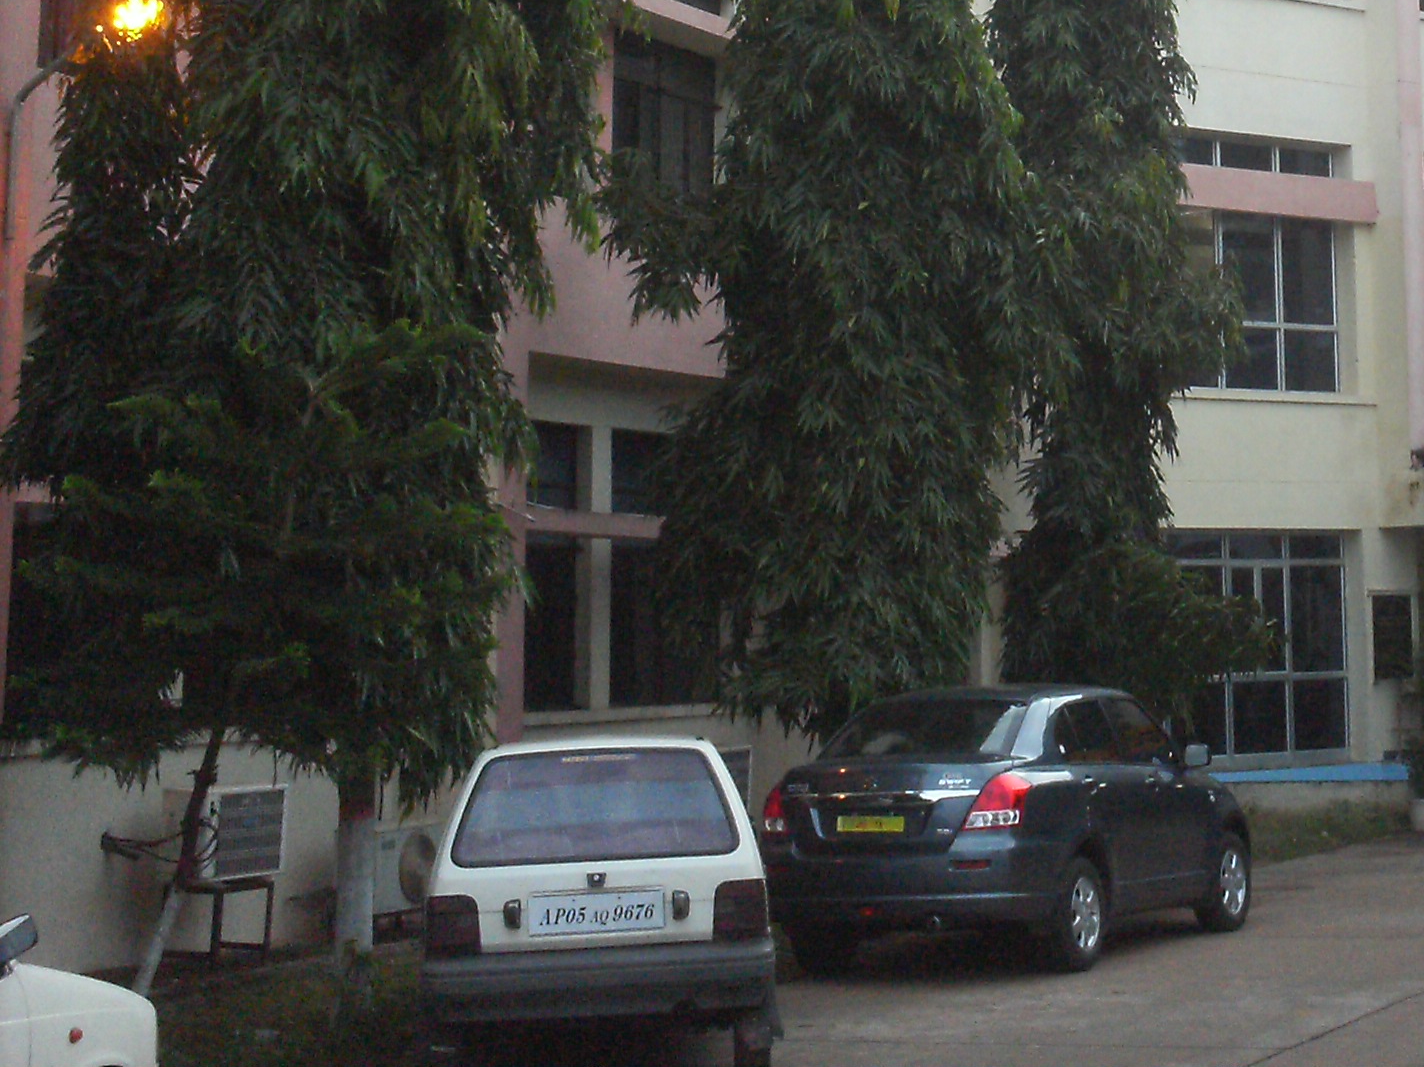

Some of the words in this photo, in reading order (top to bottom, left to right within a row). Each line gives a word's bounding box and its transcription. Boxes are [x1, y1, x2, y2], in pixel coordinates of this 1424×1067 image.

[540, 906, 587, 926] AP05
[590, 909, 609, 926] AQ
[612, 903, 655, 922] 9676
